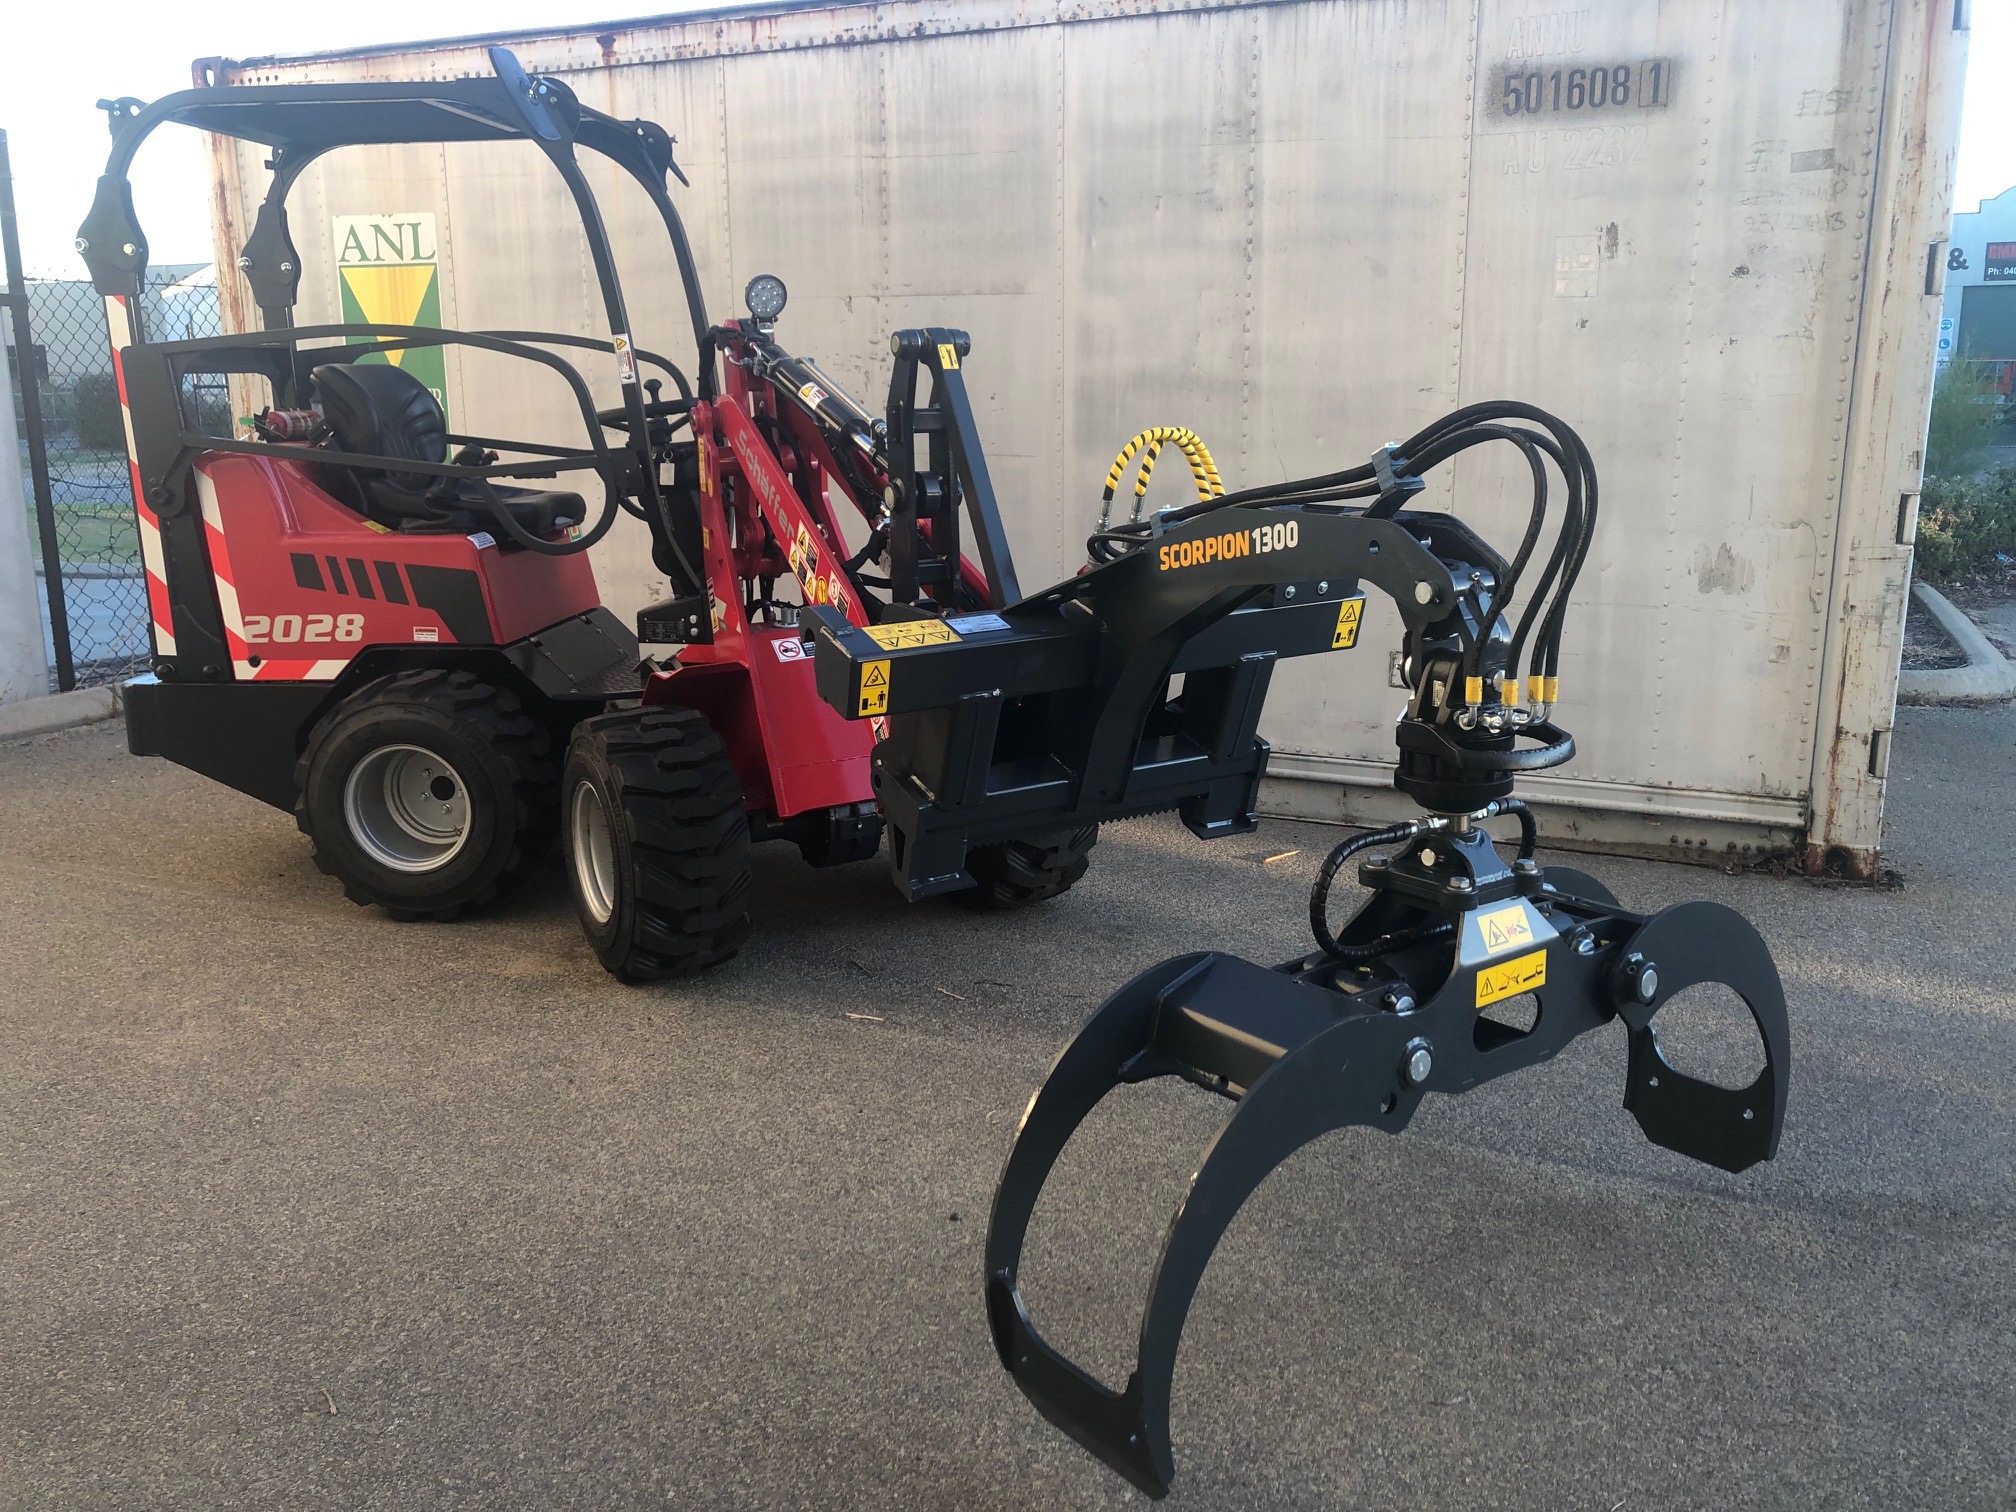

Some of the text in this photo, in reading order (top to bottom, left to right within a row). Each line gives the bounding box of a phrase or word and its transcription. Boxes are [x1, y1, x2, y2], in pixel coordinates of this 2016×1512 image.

[1502, 62, 1663, 117] 501608 1
[338, 222, 436, 263] ANL
[1947, 248, 1969, 271] &
[1987, 267, 2002, 275] Ph:
[735, 429, 795, 540] Schäffer
[1160, 520, 1299, 571] SCORPION 1300
[244, 613, 365, 644] 2028
